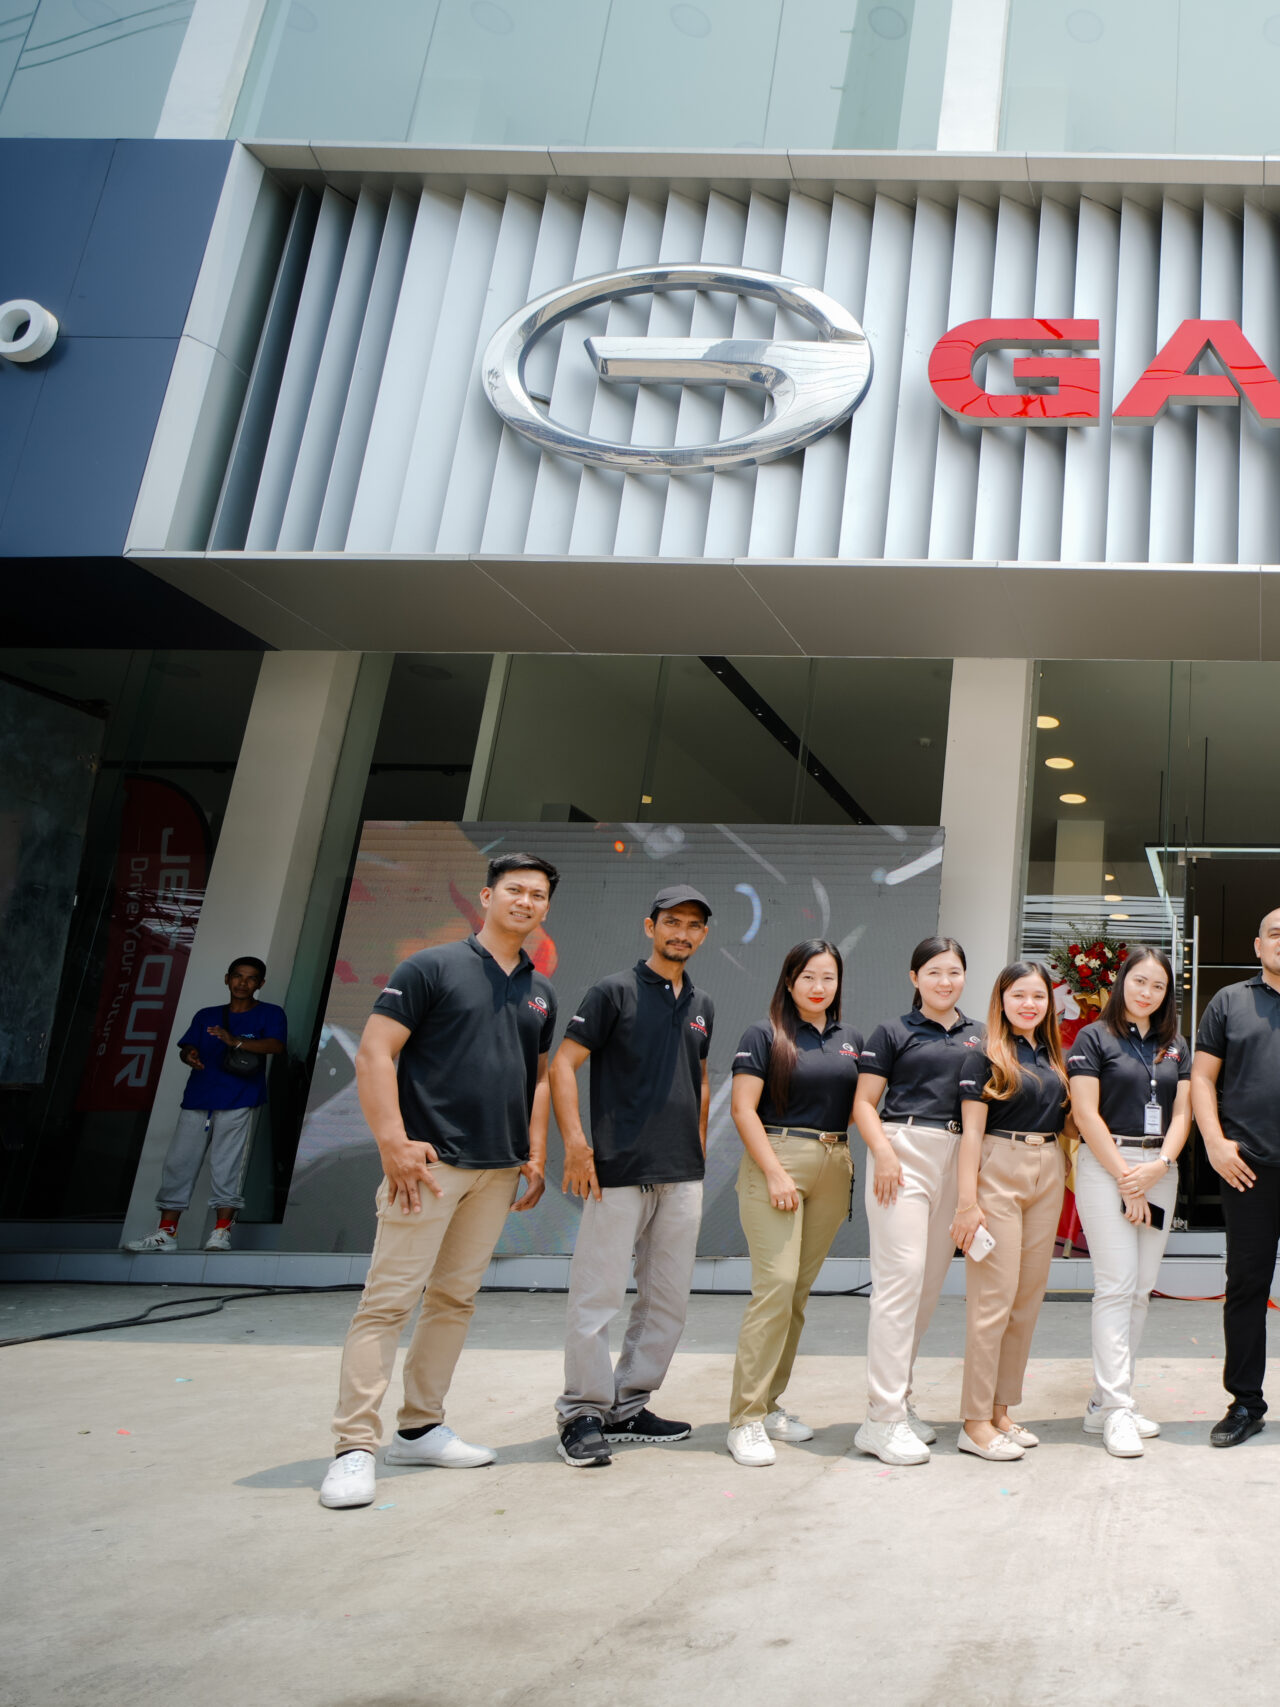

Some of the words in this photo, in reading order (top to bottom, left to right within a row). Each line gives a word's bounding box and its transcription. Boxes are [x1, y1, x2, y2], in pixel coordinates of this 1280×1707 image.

[113, 827, 191, 1087] JETOUR
[121, 920, 142, 975] Your
[96, 983, 131, 1056] Future
